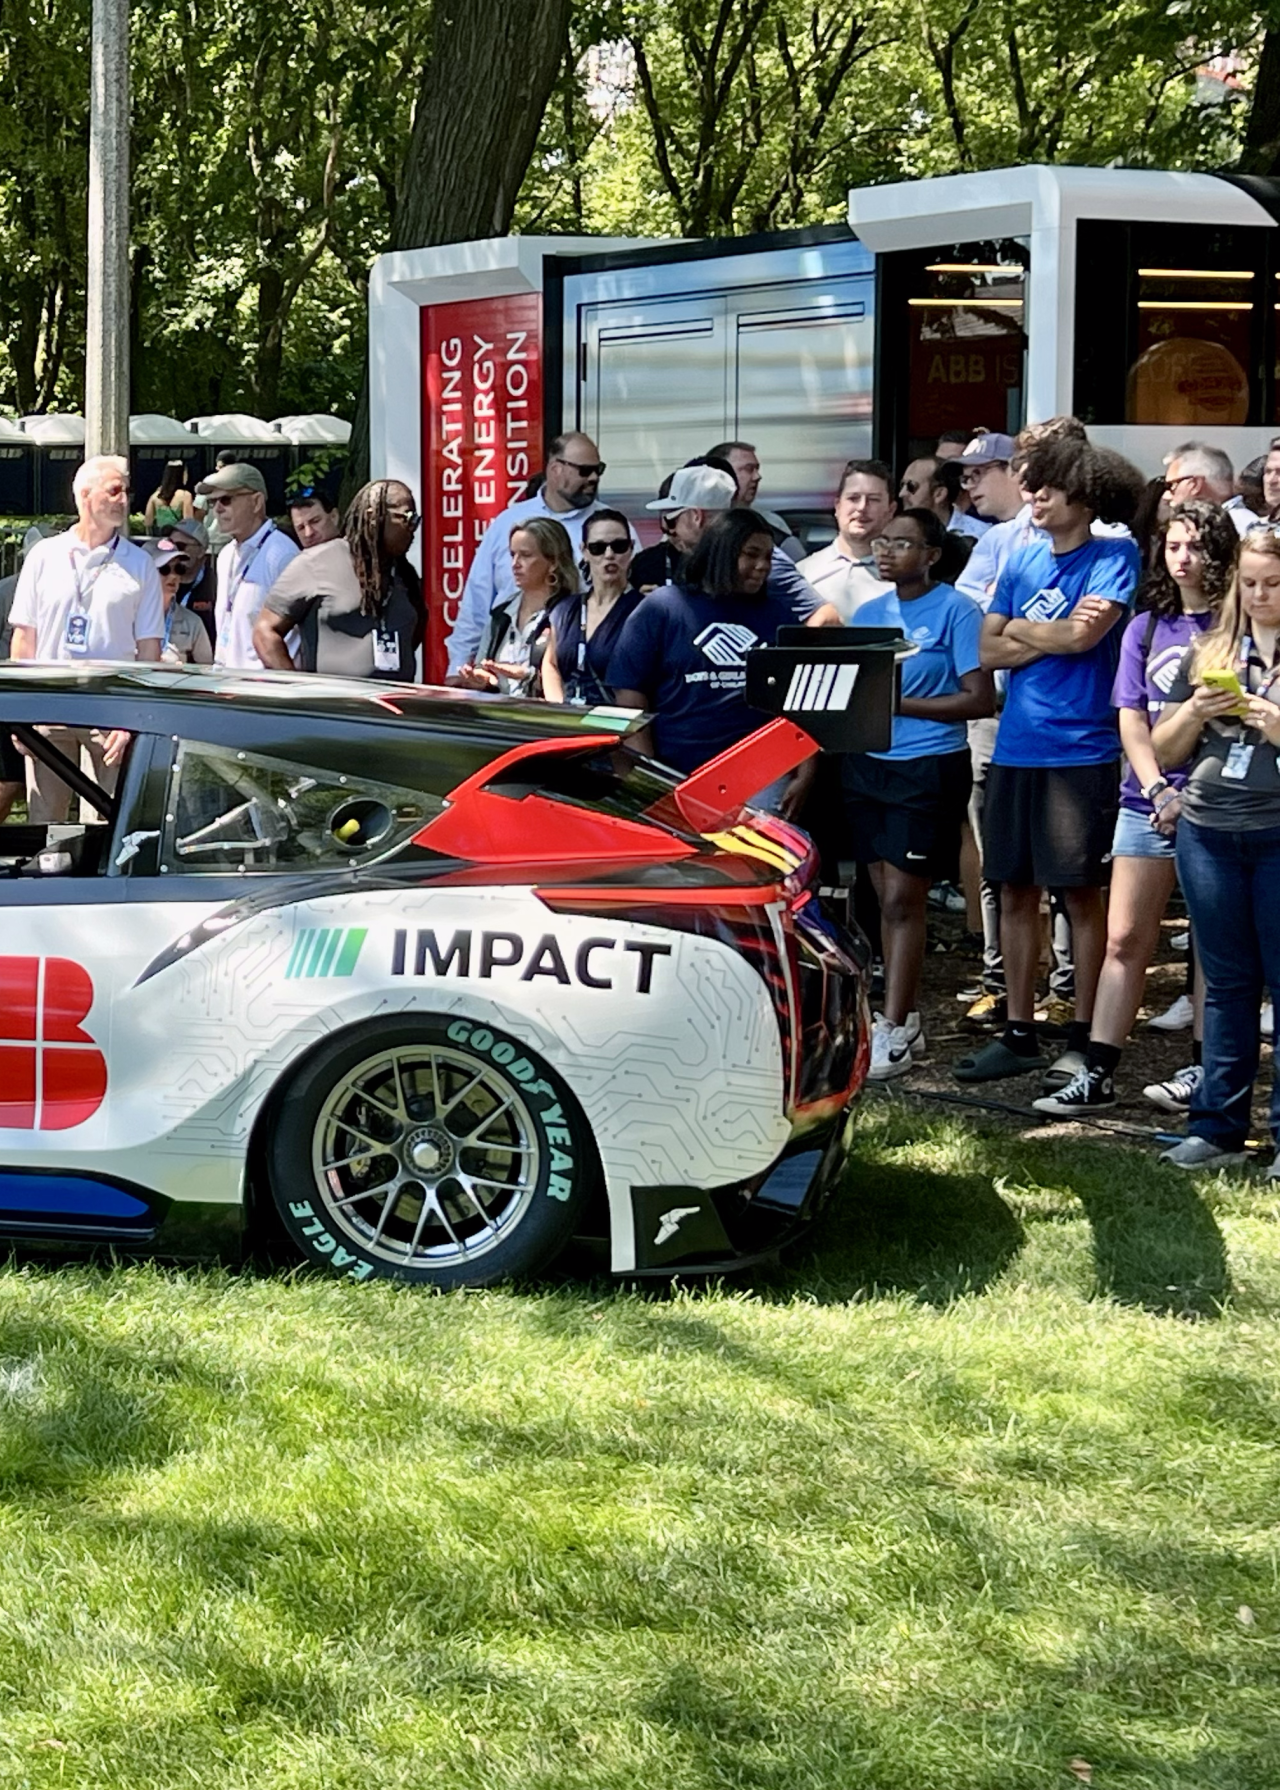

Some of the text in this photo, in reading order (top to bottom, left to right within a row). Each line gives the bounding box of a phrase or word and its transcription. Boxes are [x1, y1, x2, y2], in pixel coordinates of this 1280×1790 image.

[473, 334, 496, 505] ENERGY
[506, 331, 528, 508] NSITION
[927, 354, 986, 384] ABB
[441, 336, 463, 629] CCELERATING
[391, 928, 672, 994] IMPACT
[446, 1020, 575, 1202] GOODYEAR
[288, 1200, 375, 1280] EAGLE
